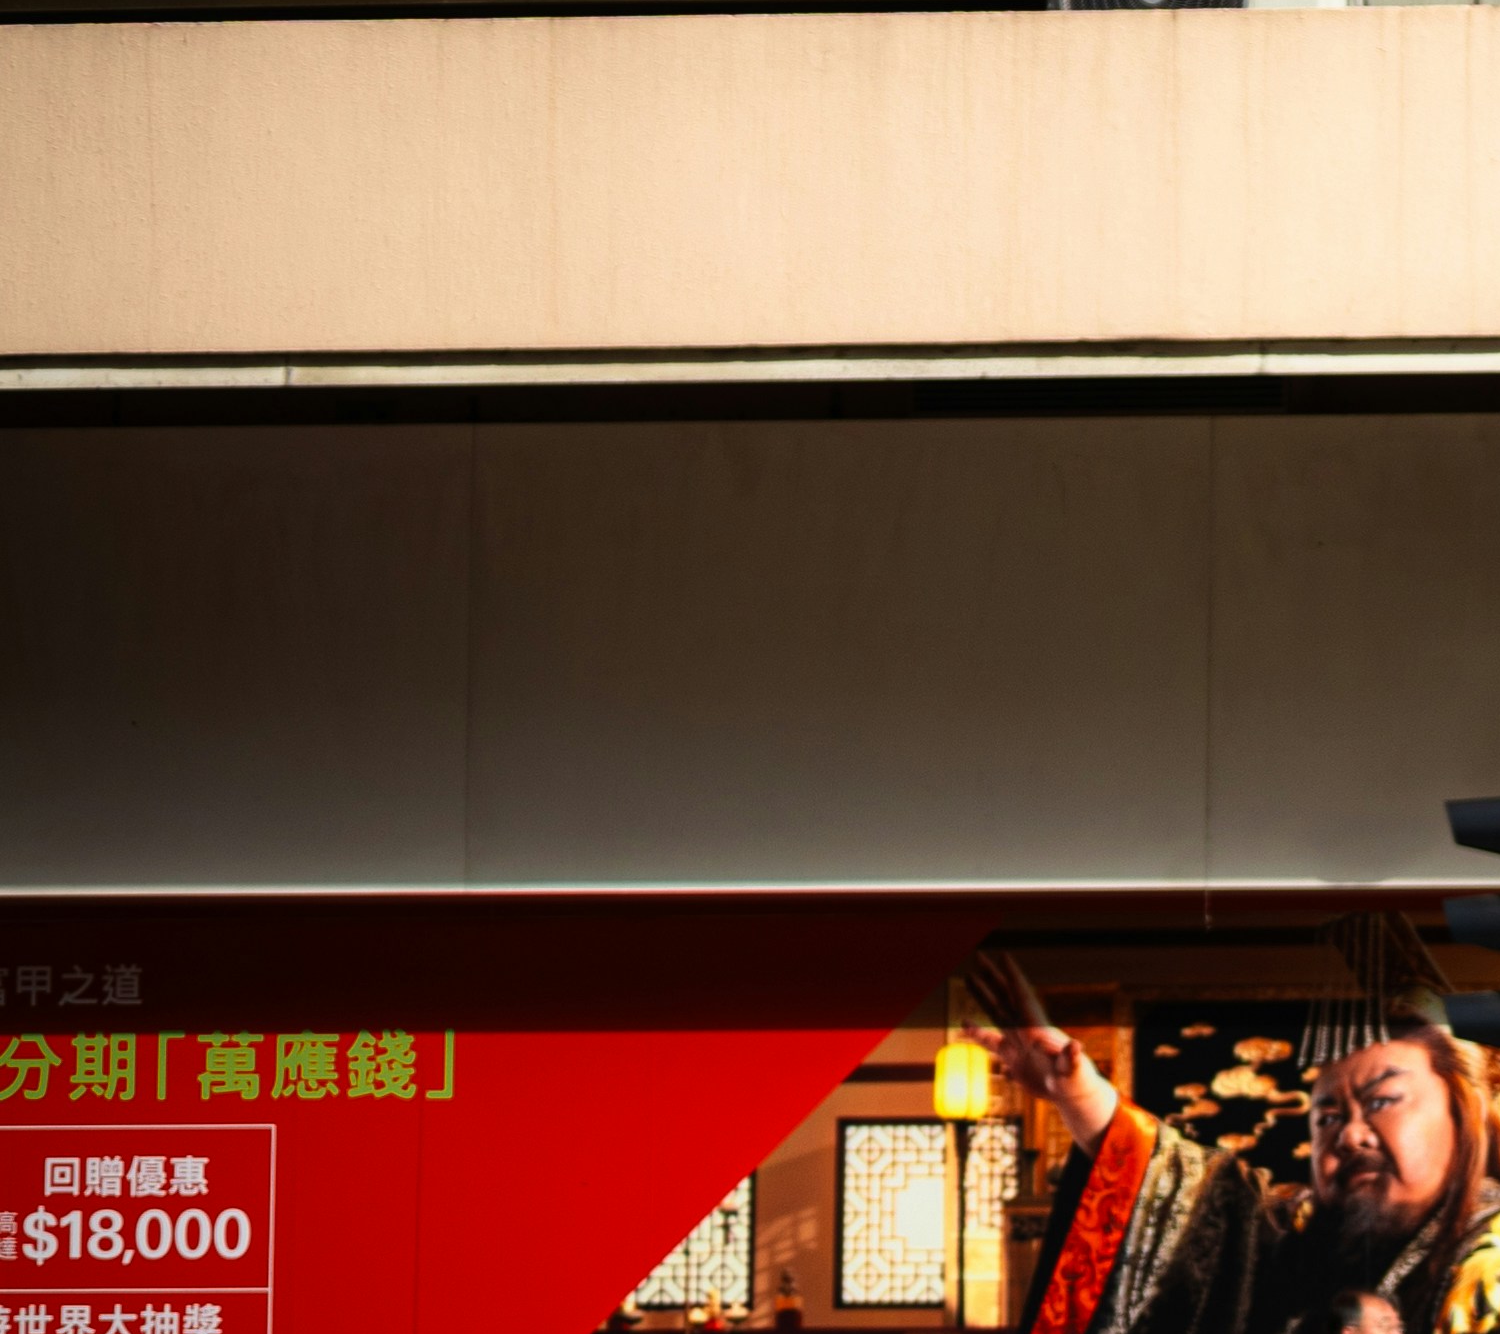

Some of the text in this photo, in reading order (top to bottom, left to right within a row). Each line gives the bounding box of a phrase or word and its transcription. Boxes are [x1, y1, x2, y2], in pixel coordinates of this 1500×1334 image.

[0, 964, 143, 1007] 甲之道
[43, 1154, 210, 1198] 回贈優惠
[22, 1204, 252, 1267] $18,000
